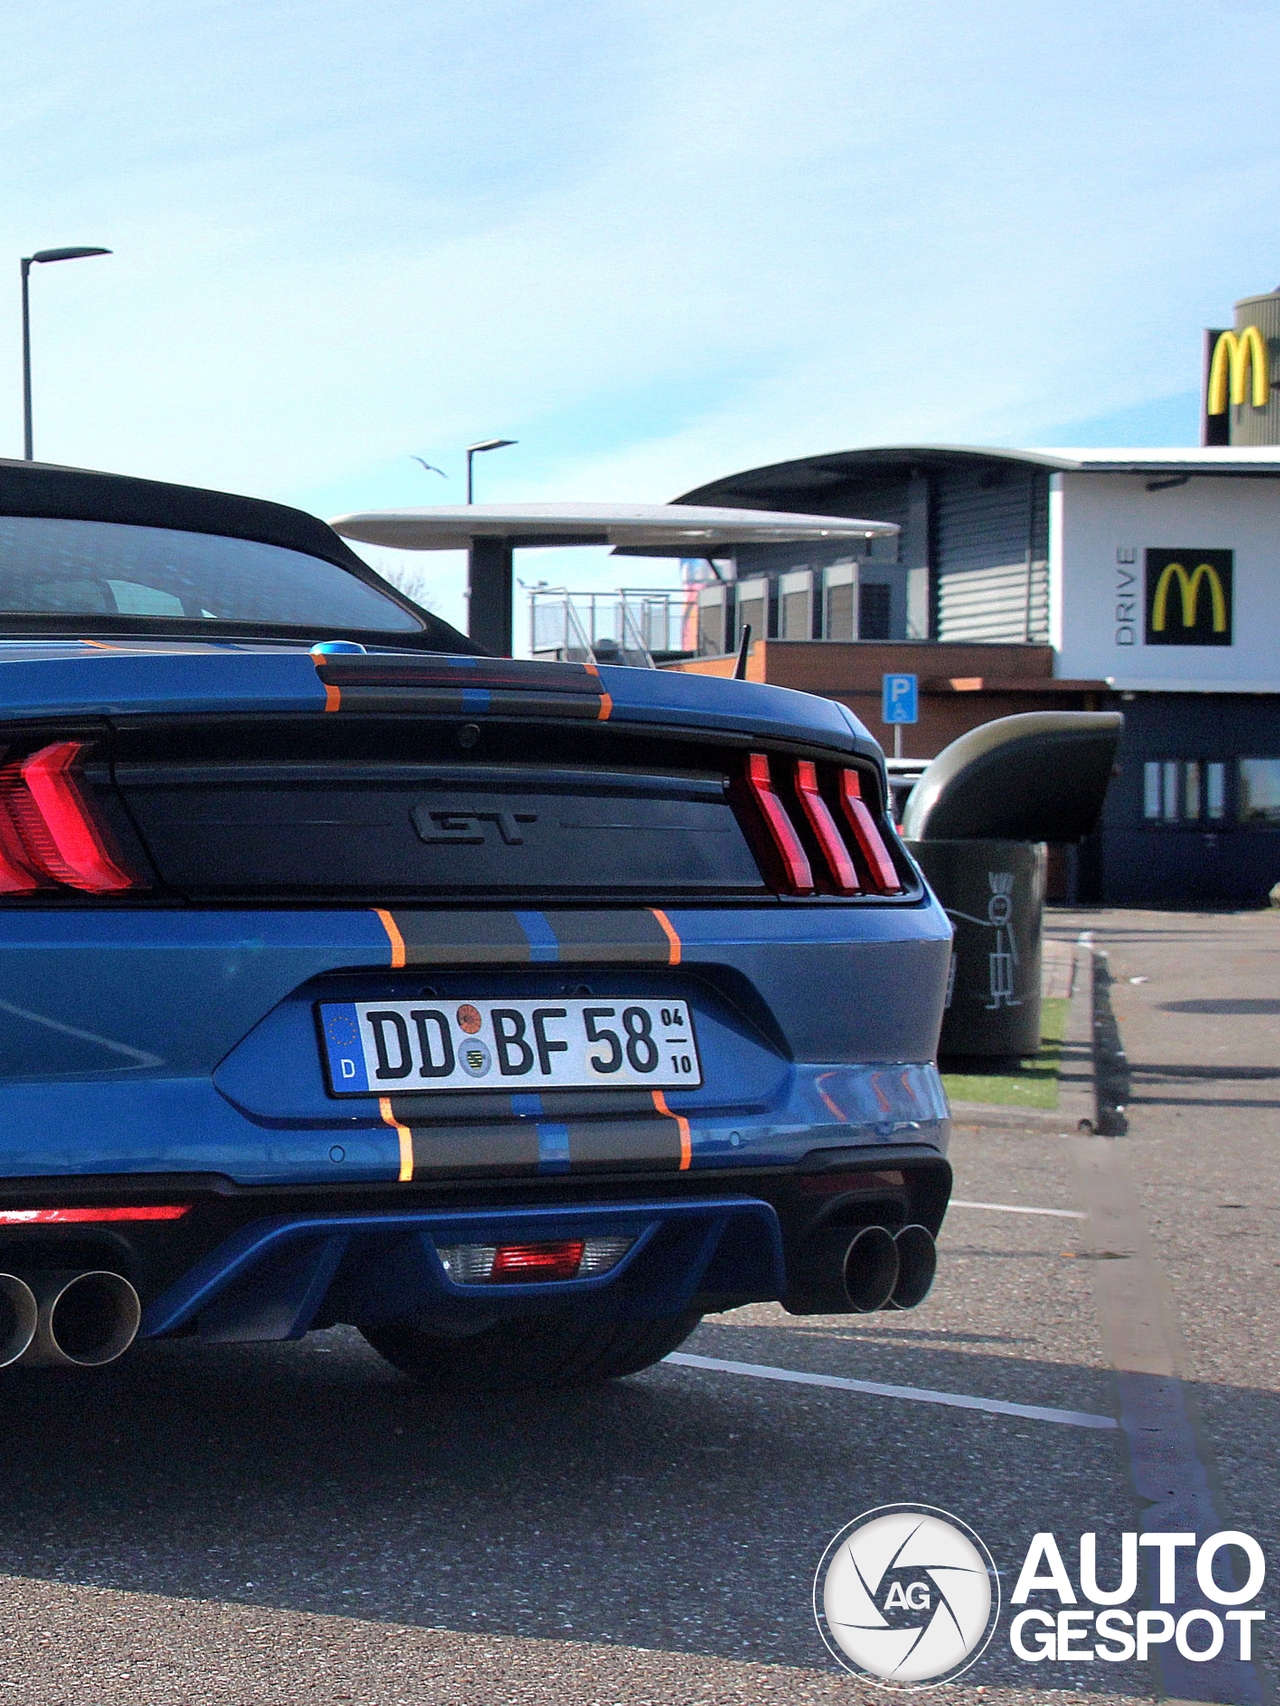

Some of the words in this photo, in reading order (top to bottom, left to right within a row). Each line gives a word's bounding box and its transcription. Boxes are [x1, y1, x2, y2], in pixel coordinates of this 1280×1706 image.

[1115, 547, 1136, 646] DRIVE
[892, 678, 911, 702] P
[409, 805, 539, 846] GT
[660, 1007, 684, 1028] 04
[366, 1008, 456, 1079] DD
[490, 1008, 569, 1076] BF
[582, 1005, 660, 1074] 58
[341, 1058, 357, 1079] D
[670, 1054, 692, 1075] 10
